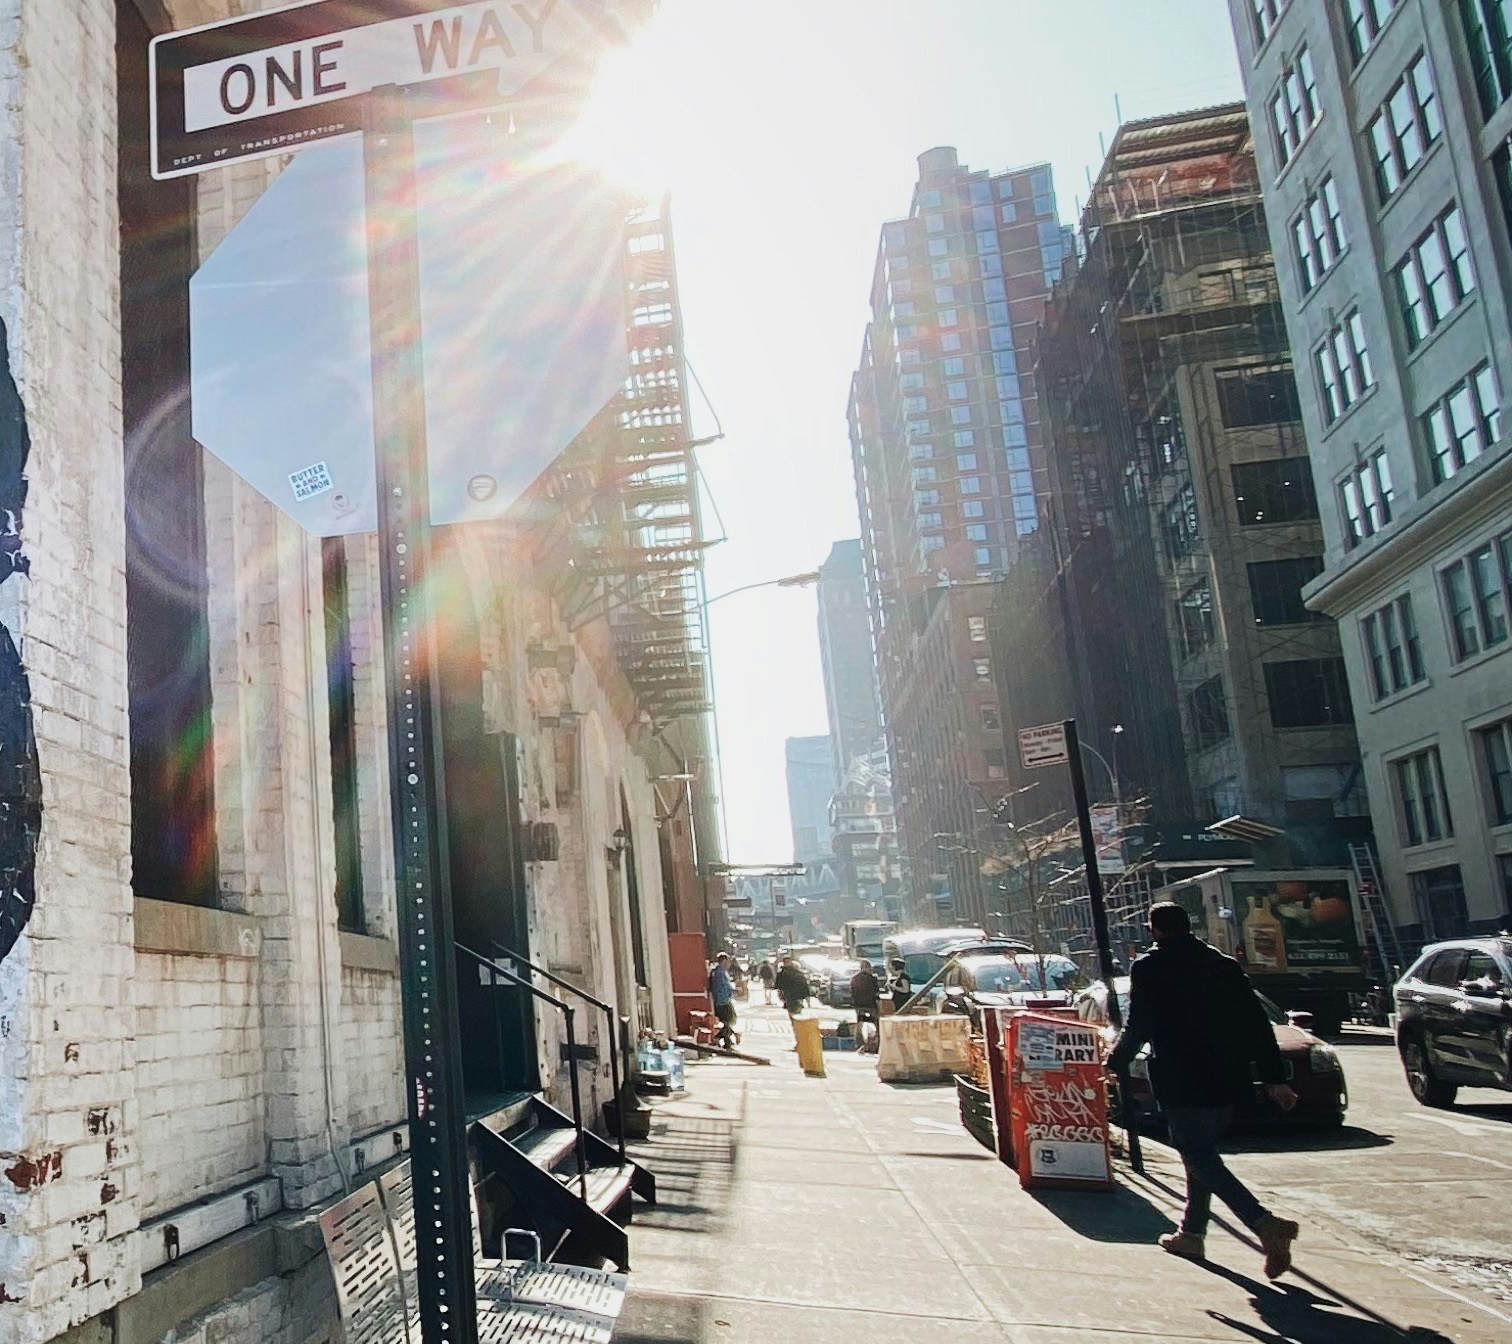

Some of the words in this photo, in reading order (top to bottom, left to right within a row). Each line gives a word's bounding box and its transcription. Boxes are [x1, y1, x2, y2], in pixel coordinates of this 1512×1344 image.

[220, 40, 346, 115] ONE
[173, 154, 202, 166] DEPT
[214, 148, 228, 157] OF
[240, 123, 345, 151] TRANSPORTATION
[290, 464, 325, 484] BUTTER
[302, 475, 319, 487] AND
[296, 478, 330, 498] SALMON
[1056, 1033, 1094, 1046] MINI
